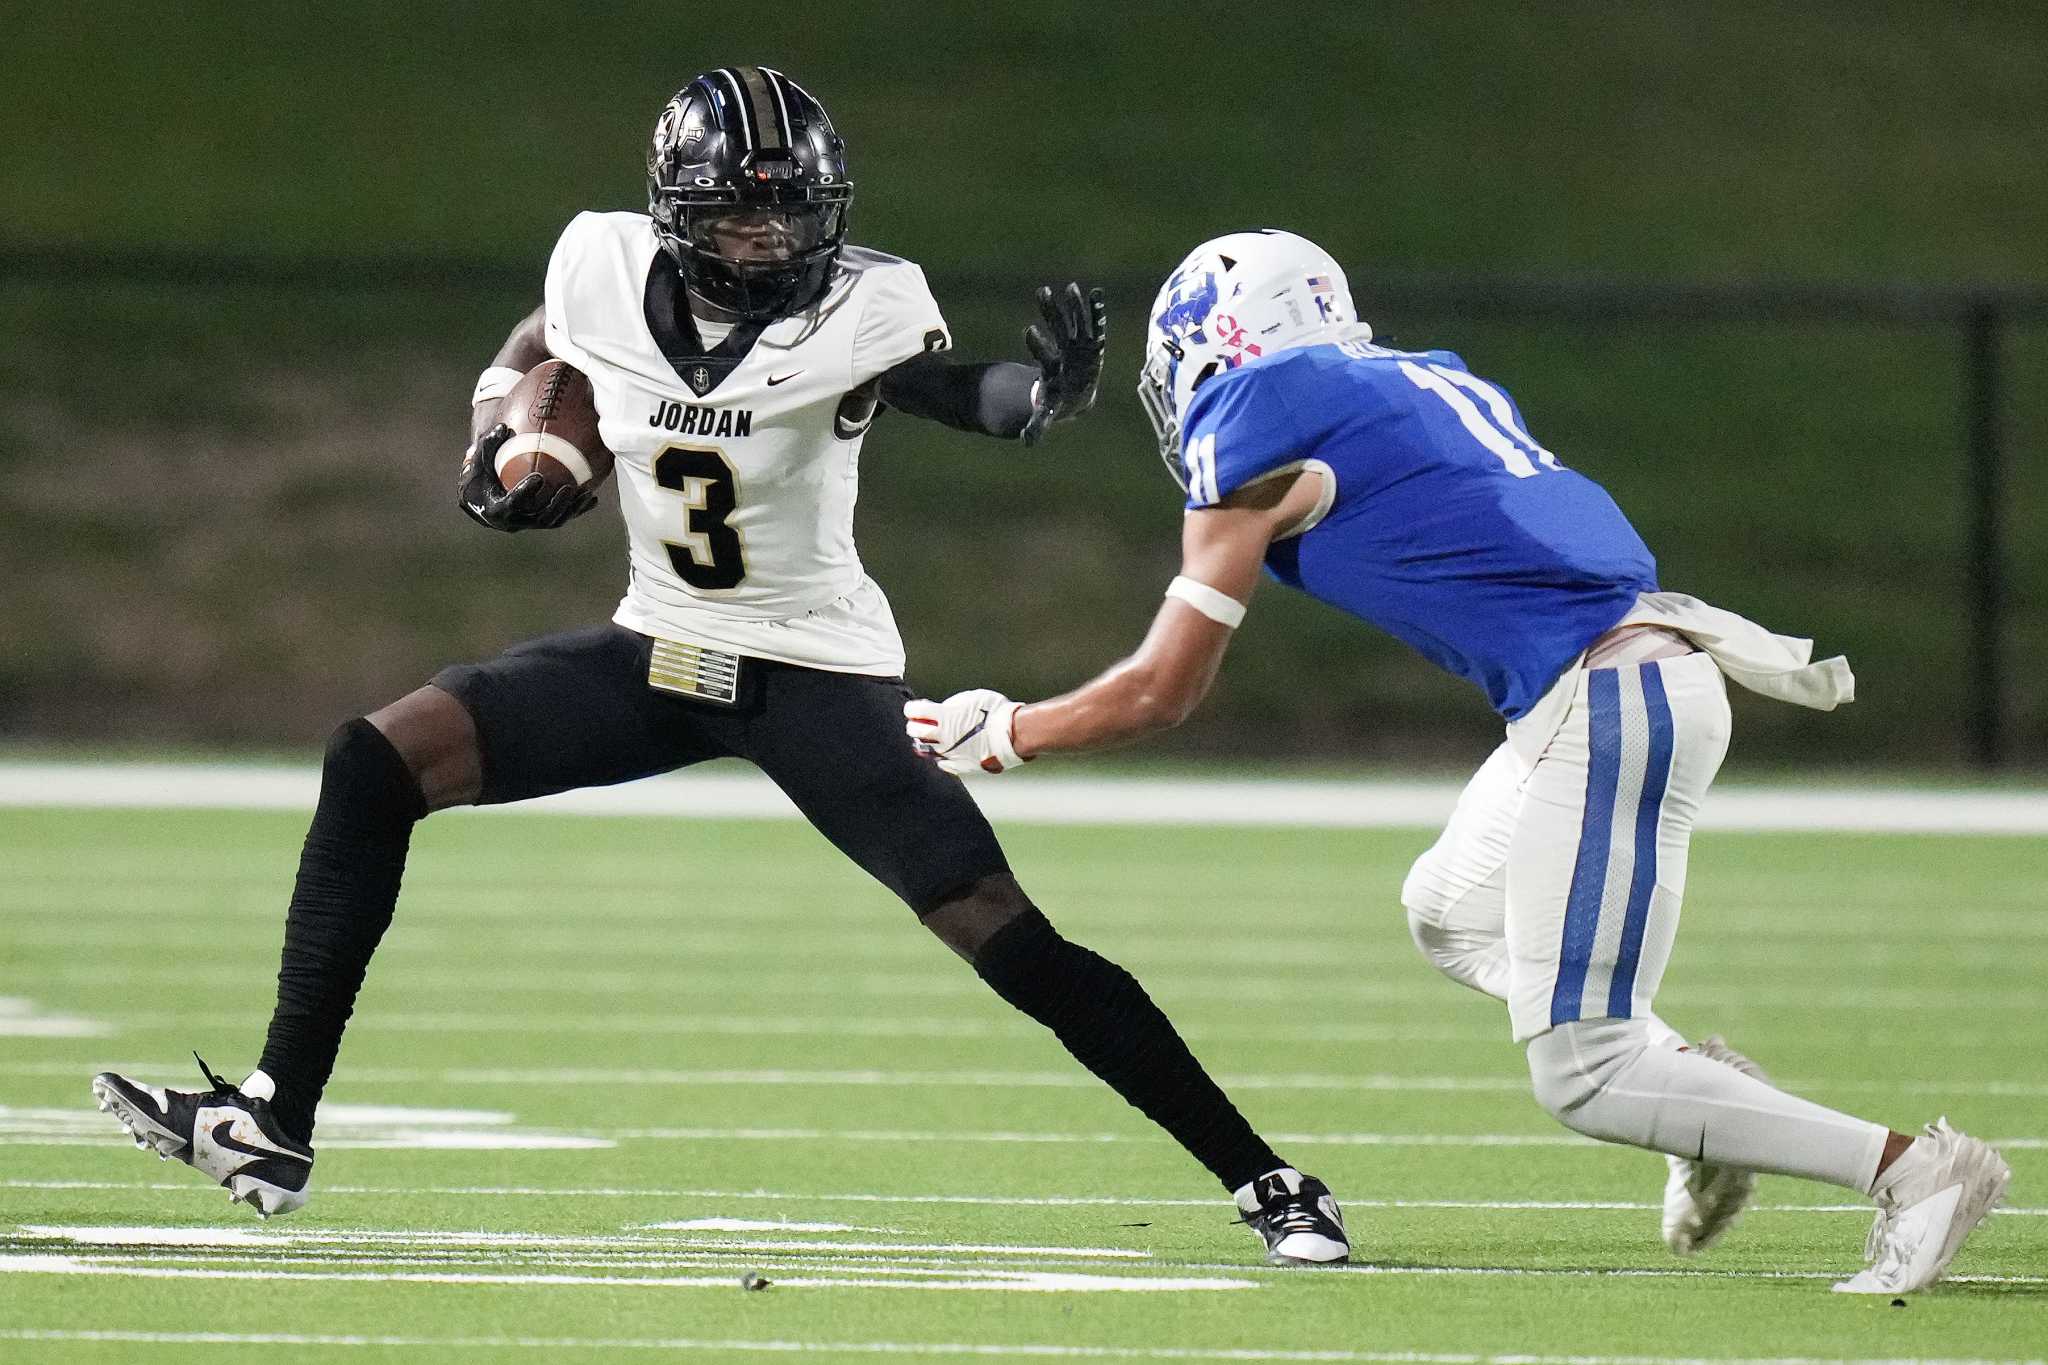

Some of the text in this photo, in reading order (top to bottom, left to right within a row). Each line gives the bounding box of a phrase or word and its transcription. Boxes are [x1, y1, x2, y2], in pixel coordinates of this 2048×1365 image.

[649, 400, 753, 438] JORDAN
[1397, 360, 1567, 479] 11
[1185, 432, 1220, 505] 11
[651, 442, 750, 596] 3
